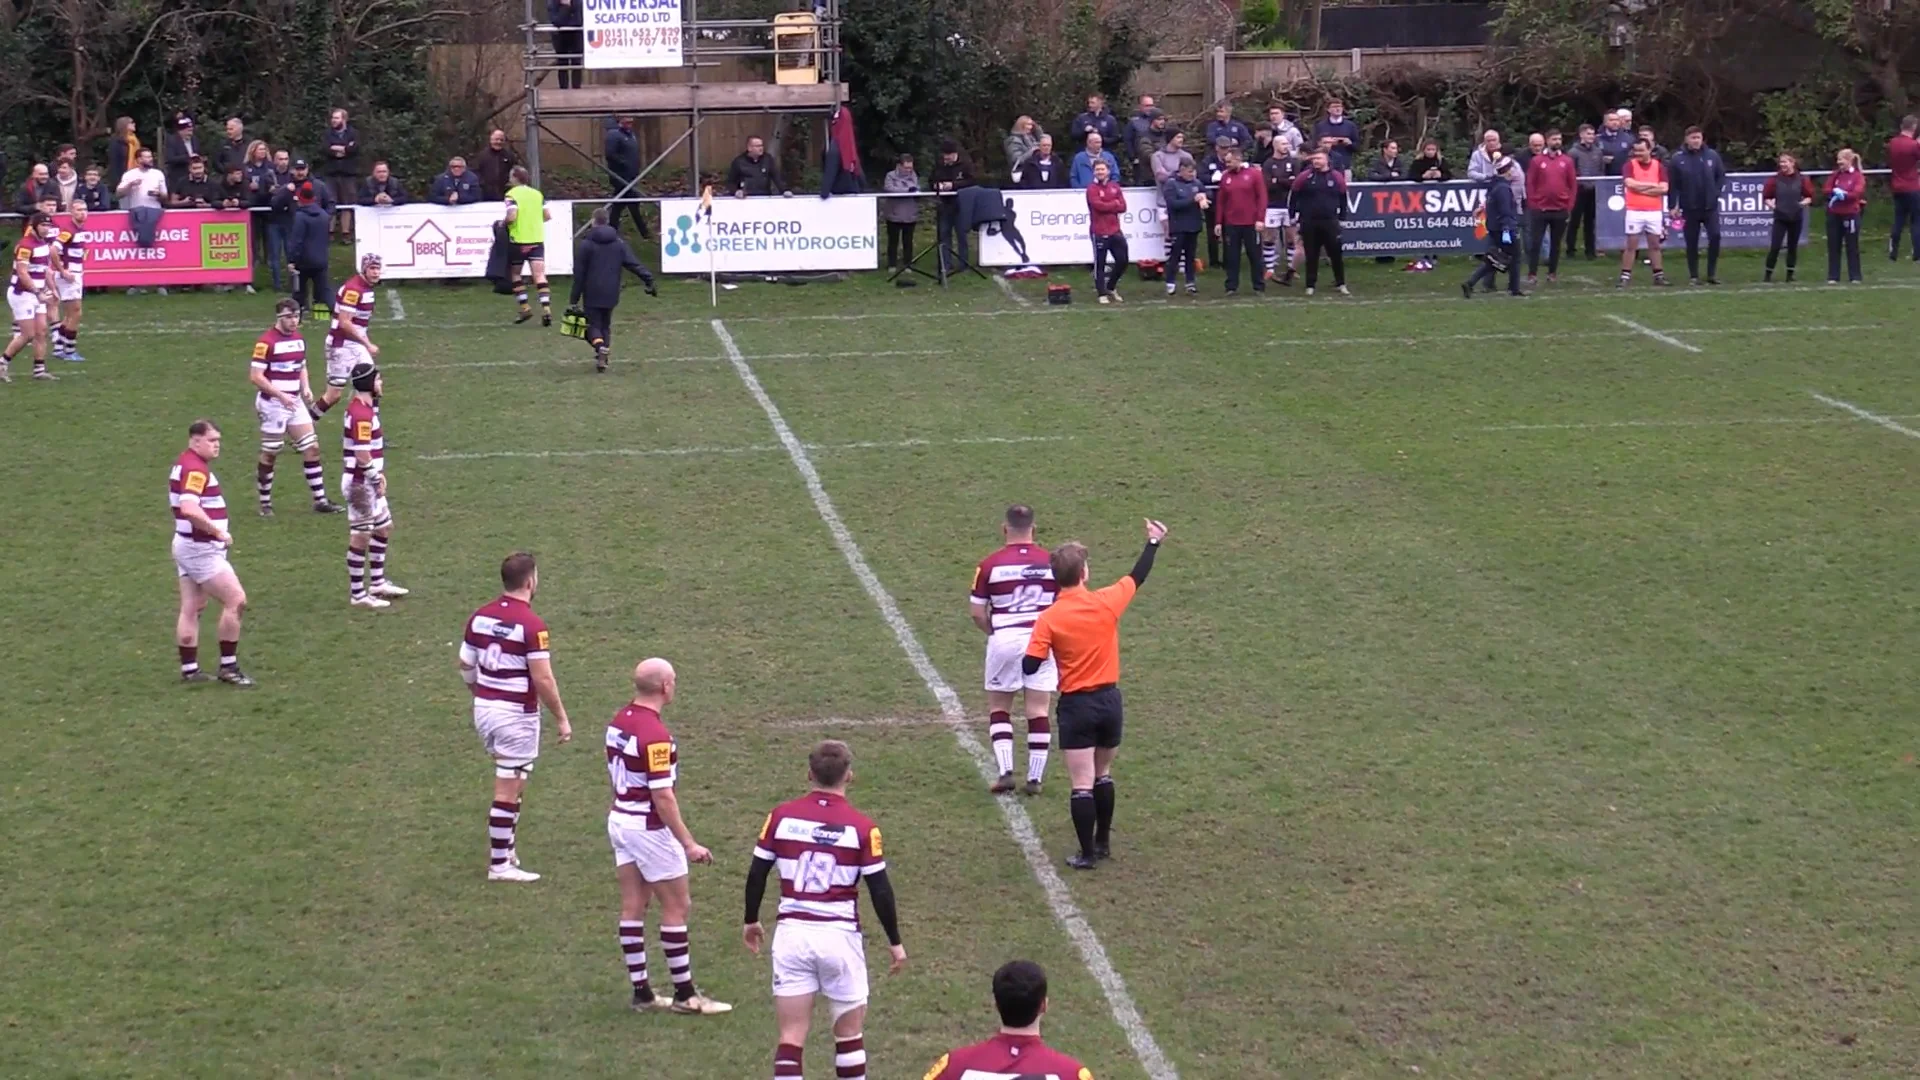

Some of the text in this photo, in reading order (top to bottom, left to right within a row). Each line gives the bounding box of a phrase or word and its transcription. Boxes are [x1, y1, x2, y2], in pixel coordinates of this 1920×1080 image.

[594, 12, 671, 24] SCAFFOLD LTD
[604, 26, 680, 39] 0151 652 7829
[604, 37, 634, 48] 07411
[1394, 217, 1425, 230] 0151
[1427, 216, 1449, 229] 644
[118, 229, 190, 243] AVAGE
[705, 235, 875, 252] GREEN HYDROGEN
[95, 248, 165, 261] LAWYERS
[209, 250, 240, 262] Legal
[1008, 584, 1043, 612] 12
